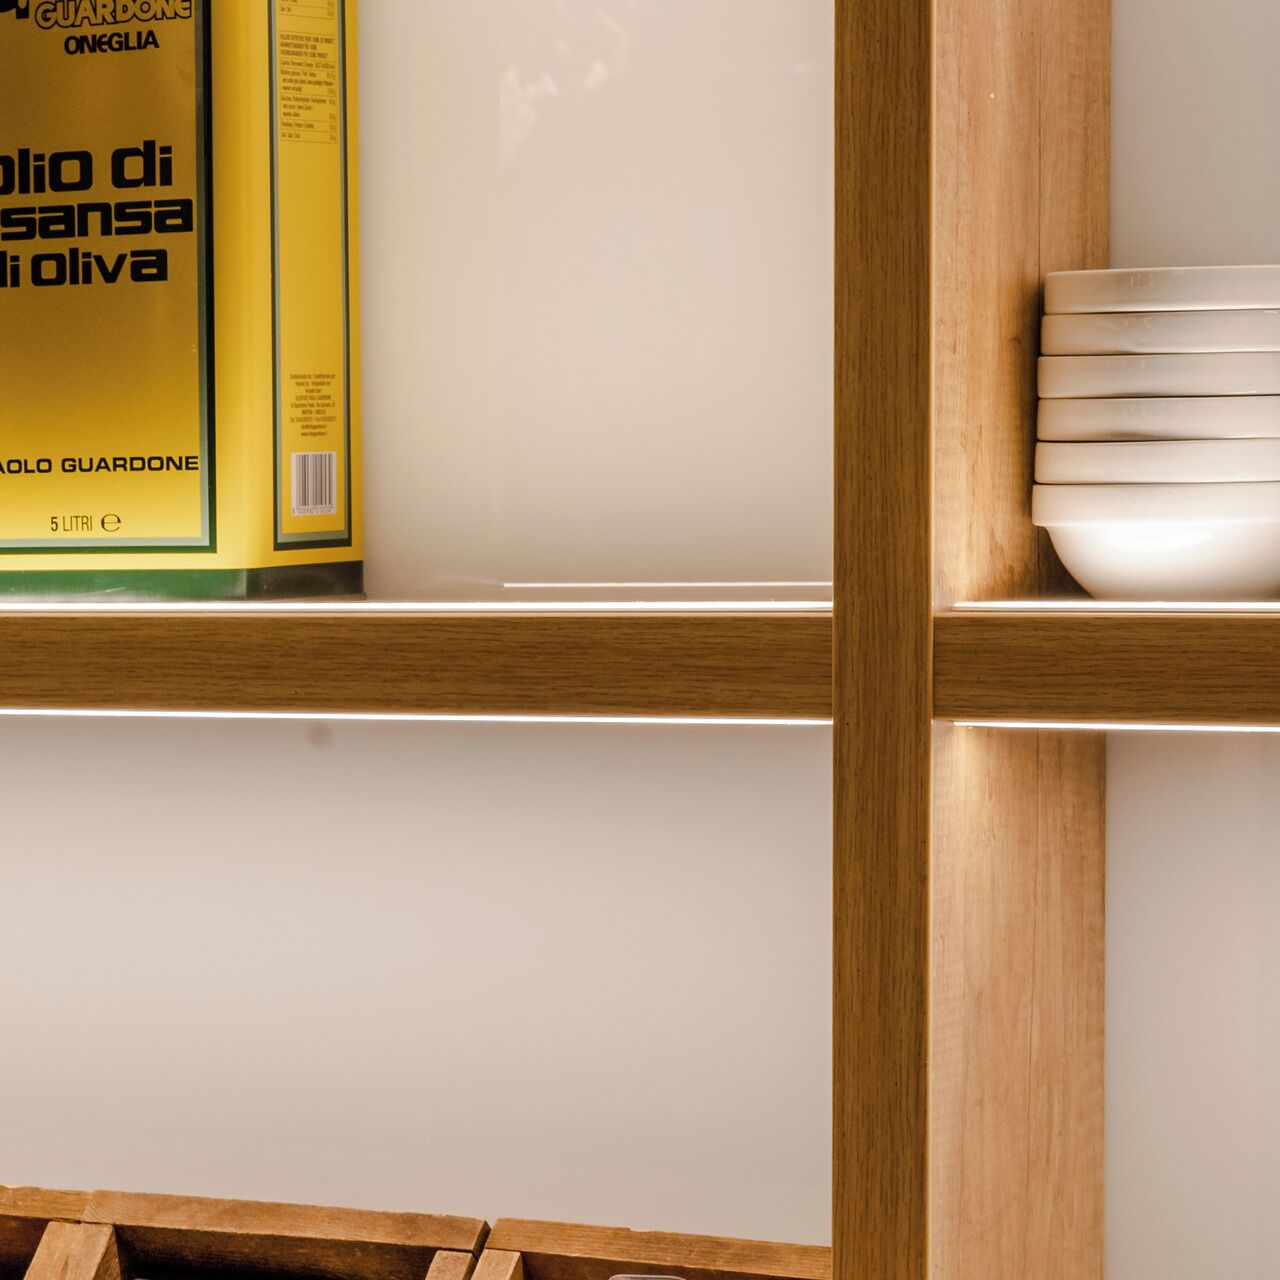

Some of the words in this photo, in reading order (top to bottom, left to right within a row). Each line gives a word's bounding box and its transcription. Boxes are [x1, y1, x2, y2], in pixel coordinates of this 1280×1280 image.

[64, 30, 159, 55] ONEGLIA
[111, 140, 173, 189] di
[0, 199, 193, 241] sansa
[31, 247, 168, 286] oliva
[62, 455, 199, 473] GUARDONE
[50, 516, 58, 532] 5
[62, 515, 93, 532] LITRI
